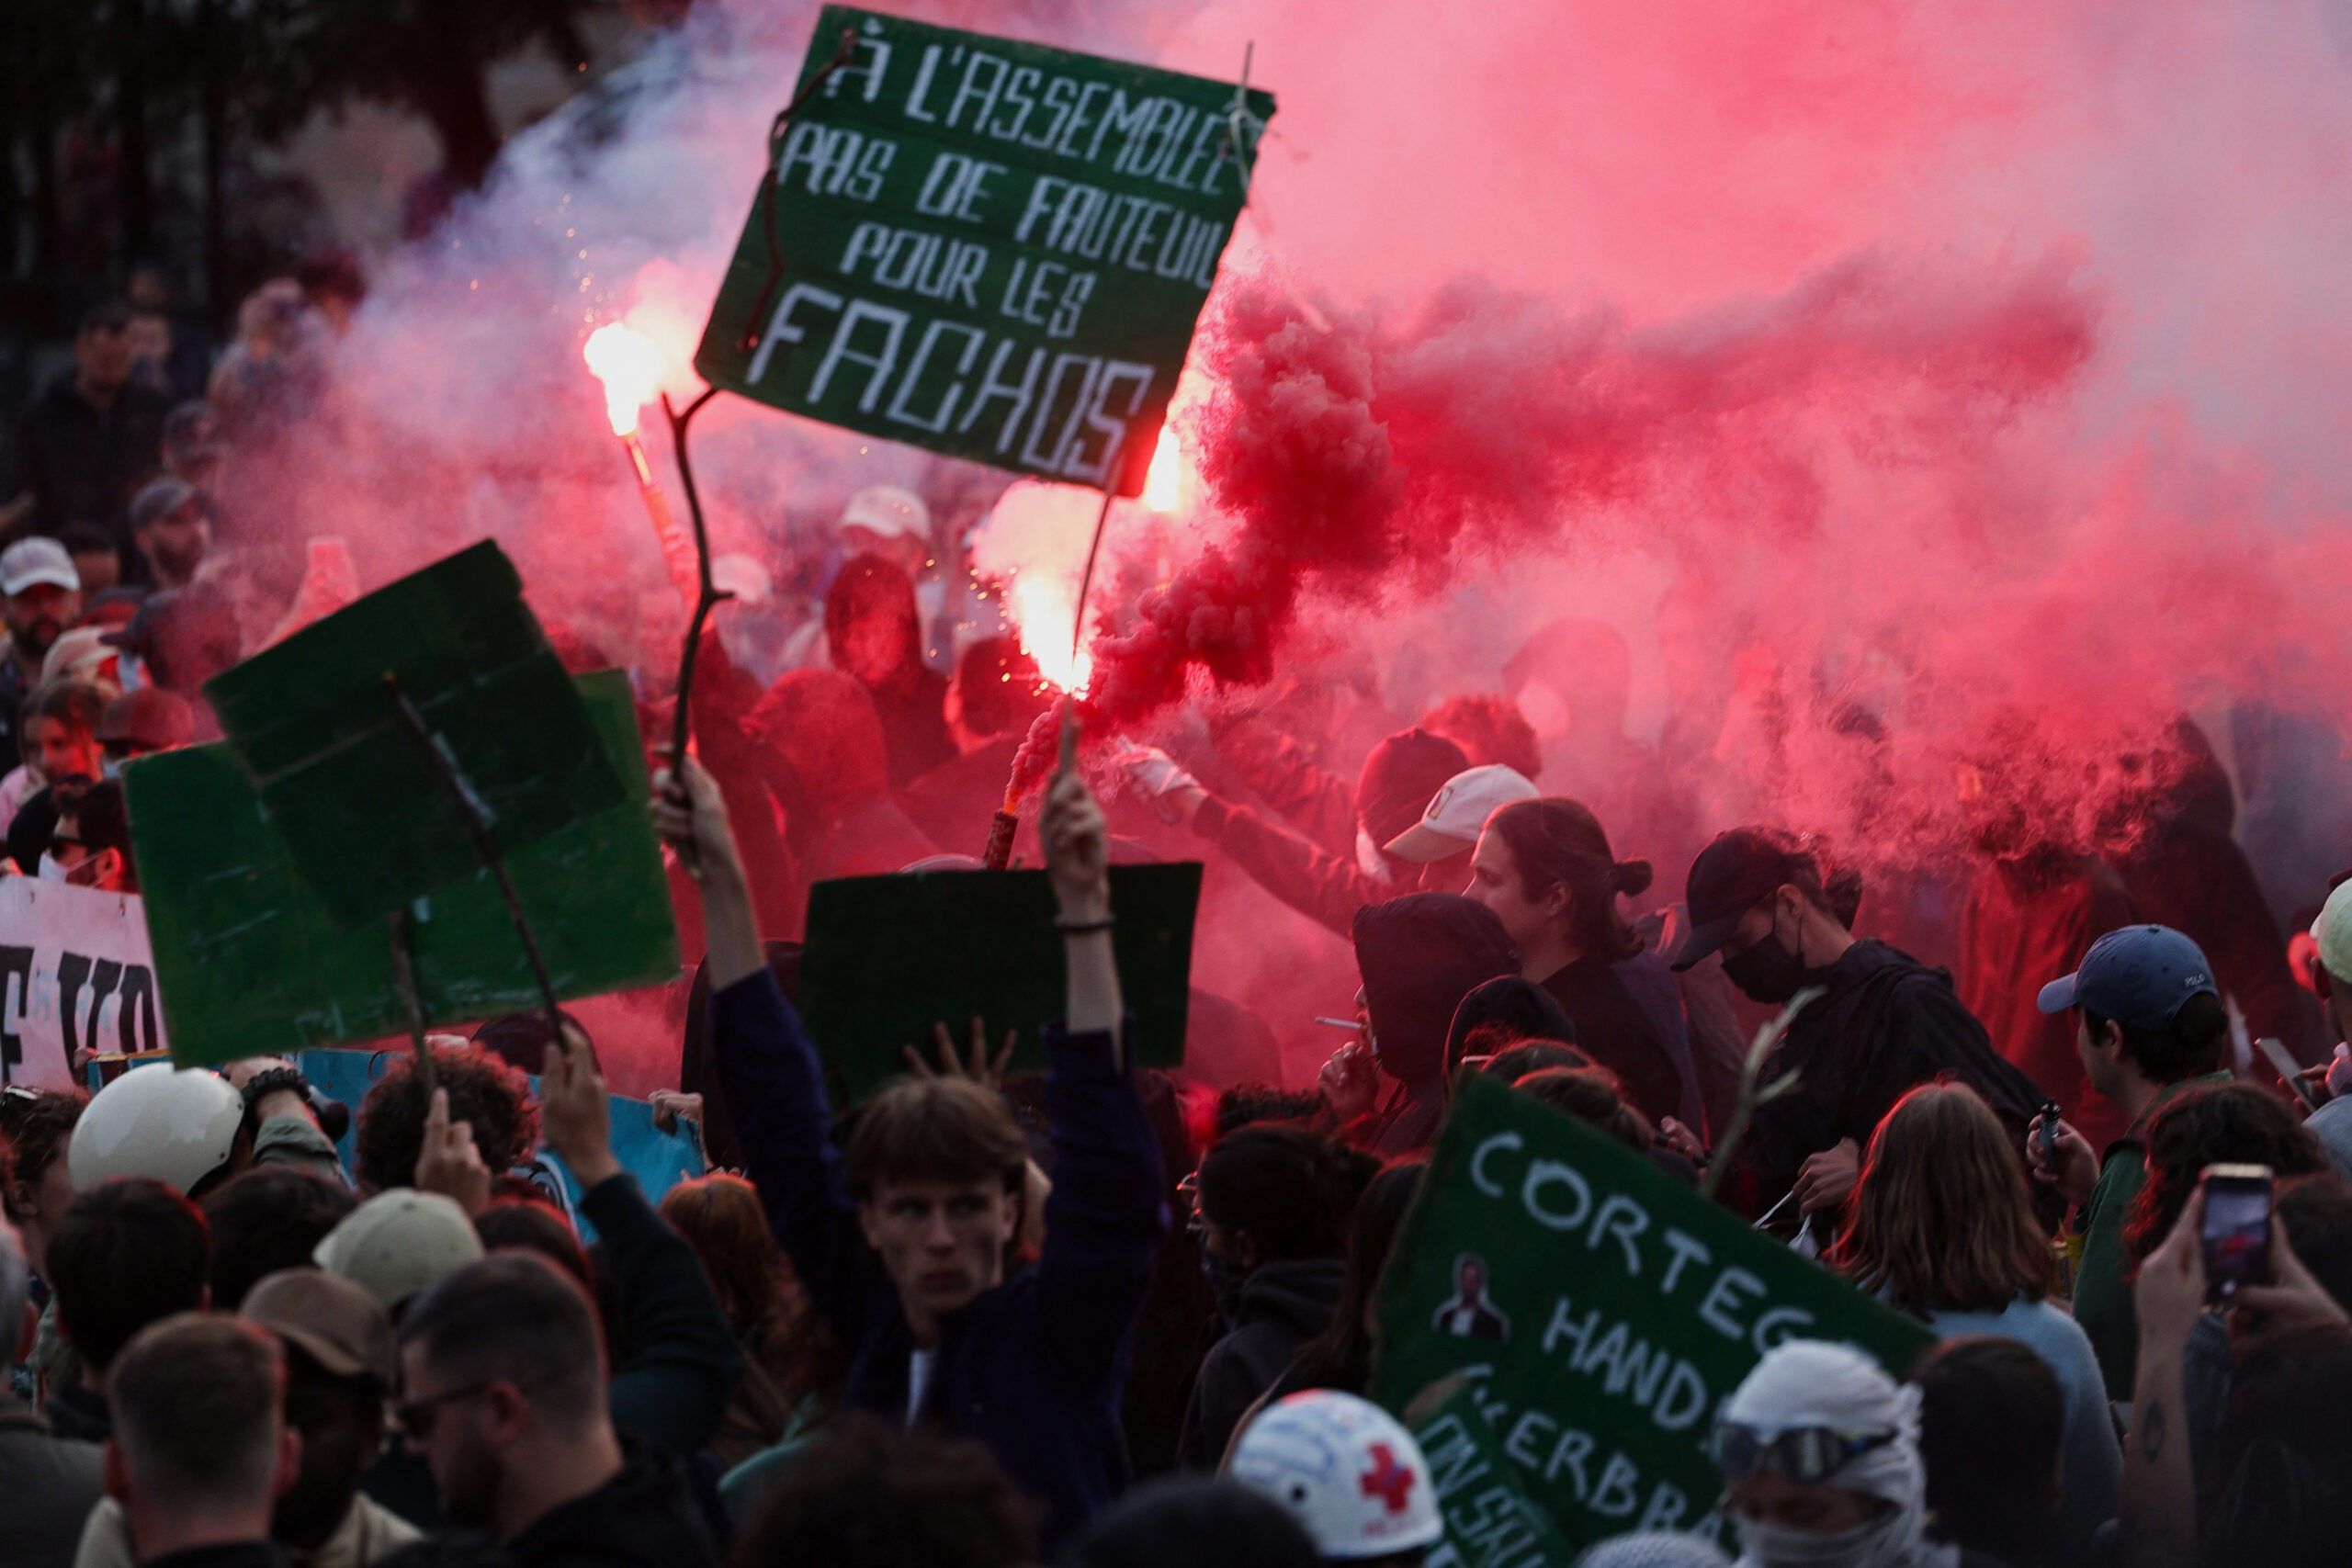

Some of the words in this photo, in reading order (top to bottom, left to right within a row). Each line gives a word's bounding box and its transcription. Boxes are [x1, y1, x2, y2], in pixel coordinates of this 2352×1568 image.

[777, 119, 897, 203] PAS
[917, 152, 1006, 224] DE
[1015, 175, 1223, 290] FAUTEUIL
[840, 220, 988, 309] POUR
[1001, 258, 1094, 338] LES
[746, 281, 1156, 480] FACHOS
[1472, 1131, 1816, 1355] CORTEG
[1464, 1363, 1725, 1536] ERBRA
